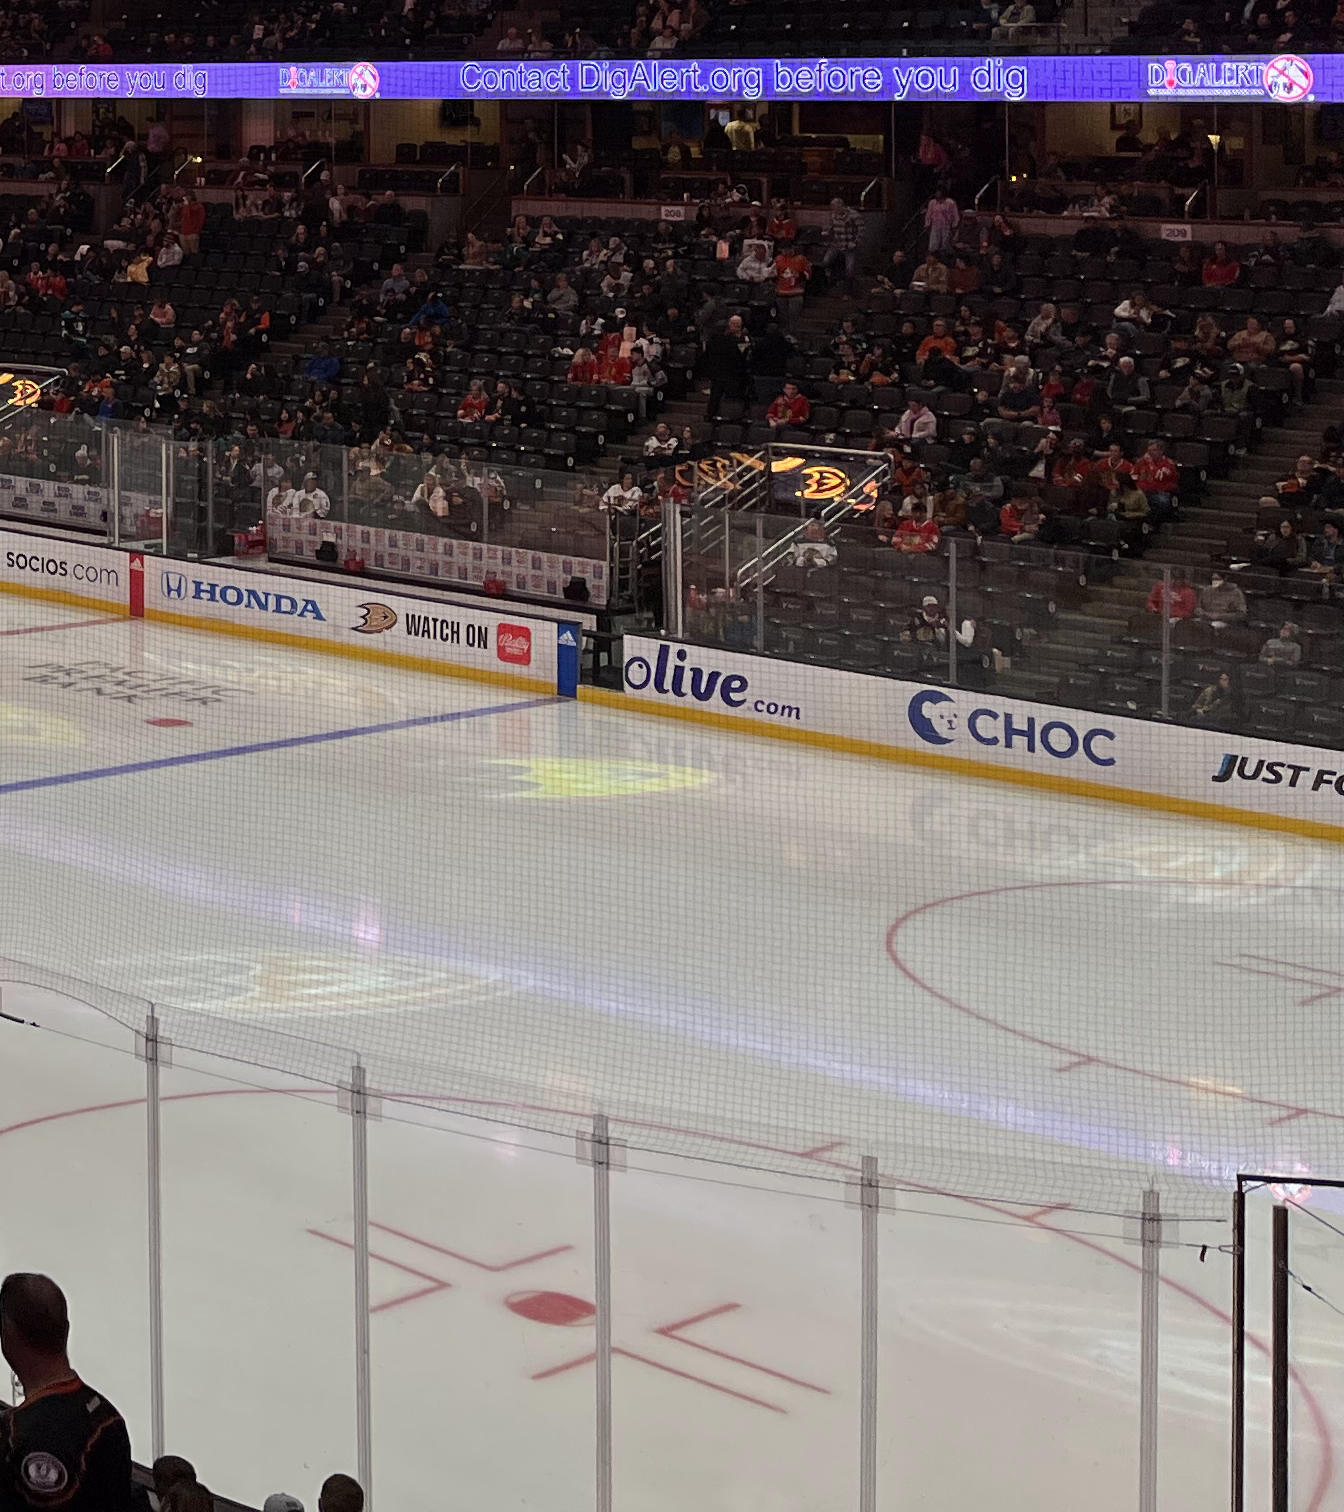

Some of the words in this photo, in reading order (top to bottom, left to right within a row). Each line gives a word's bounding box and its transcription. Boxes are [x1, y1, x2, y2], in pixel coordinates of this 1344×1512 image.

[53, 65, 119, 91] before
[126, 69, 166, 95] you
[174, 64, 207, 97] dig
[460, 61, 570, 93] Contact
[579, 61, 763, 99] DigAlert.org
[774, 58, 882, 93] before
[893, 65, 961, 101] you
[970, 58, 1028, 101] dig
[191, 579, 326, 622] HONDA
[405, 612, 460, 645] WATCH
[466, 623, 489, 650] ON
[968, 707, 1116, 768] CHOC
[1212, 752, 1310, 788] JUST
